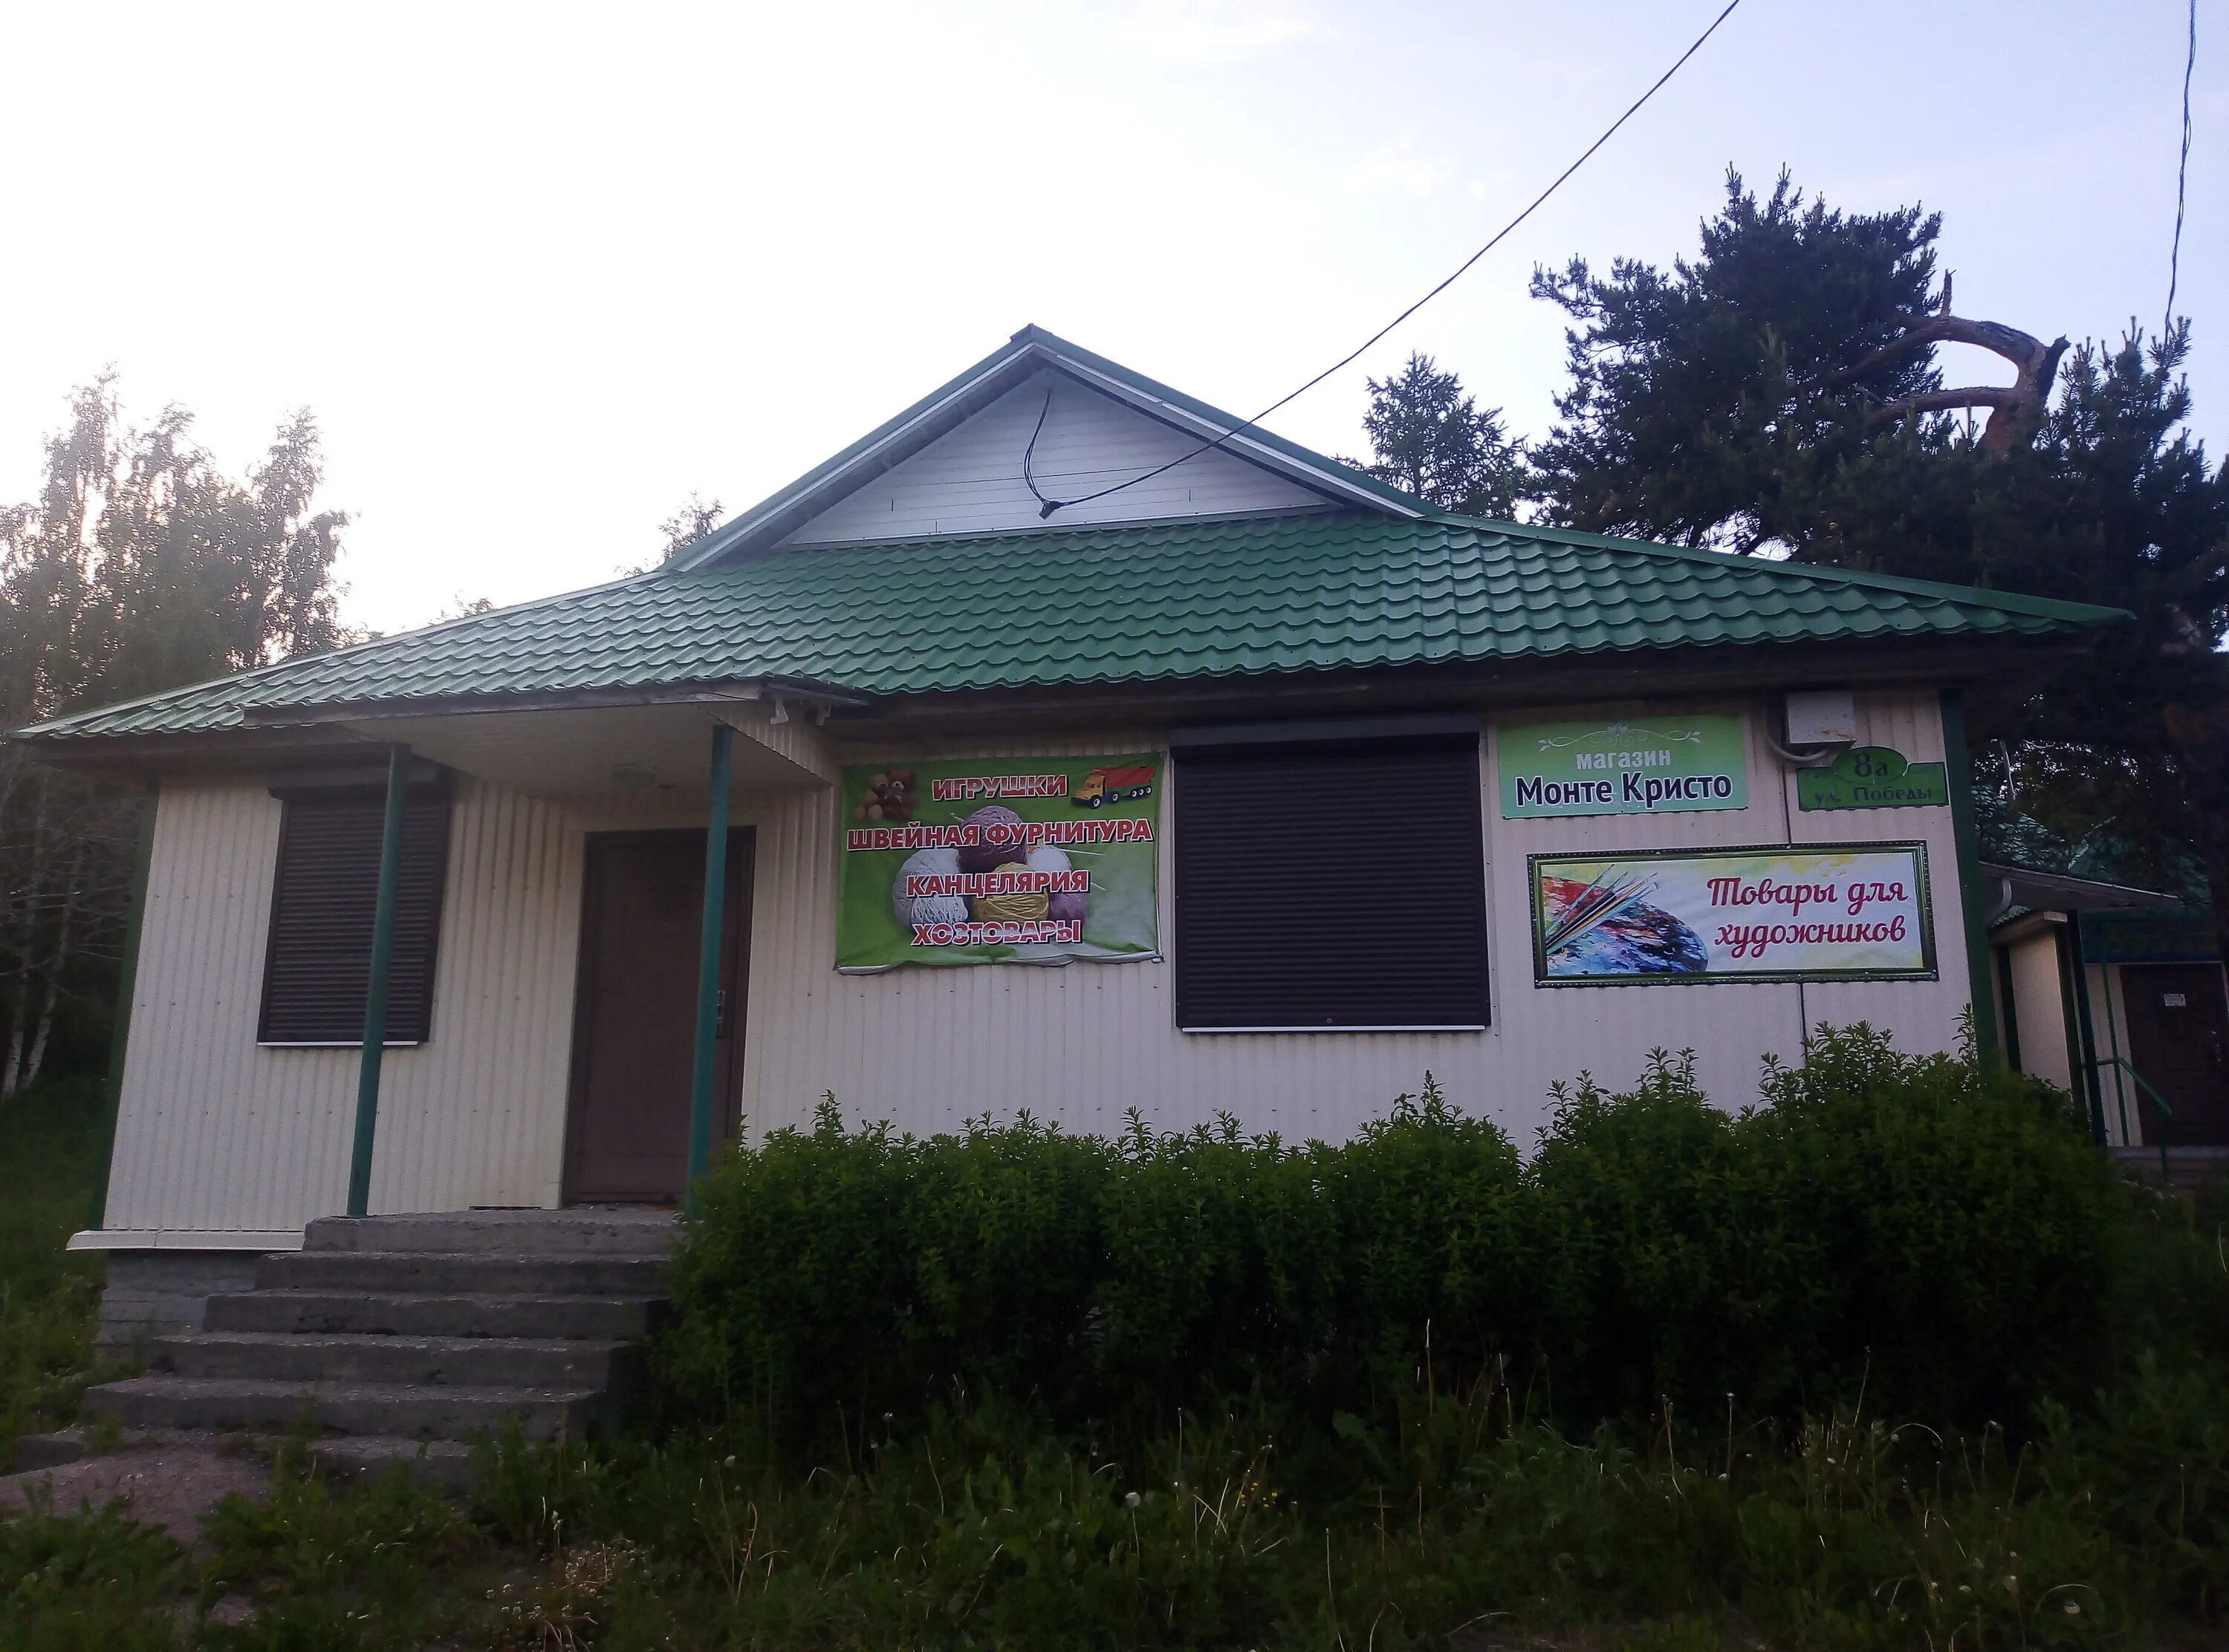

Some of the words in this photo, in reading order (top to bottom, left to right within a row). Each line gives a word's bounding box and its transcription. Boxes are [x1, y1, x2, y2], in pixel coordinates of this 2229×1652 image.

[1576, 749, 1670, 770] магазин
[1855, 753, 1888, 777] 8а
[932, 775, 1068, 801] ИГРУШКИ
[1516, 775, 1613, 807] Монте
[1621, 772, 1733, 809] Кристо
[1814, 792, 1842, 807] ул.
[1853, 786, 1932, 801] Победы
[847, 822, 980, 851] ШВЕЙНАЯ
[986, 819, 1154, 845] ФУРНИТУРА
[906, 870, 1090, 898] КАНЦЕЛЯРИЯ
[1707, 877, 1837, 916] Товары
[1846, 882, 1908, 916] для
[911, 920, 1083, 946] ХОЗТОВАРЫ
[1713, 914, 1907, 959] художников
